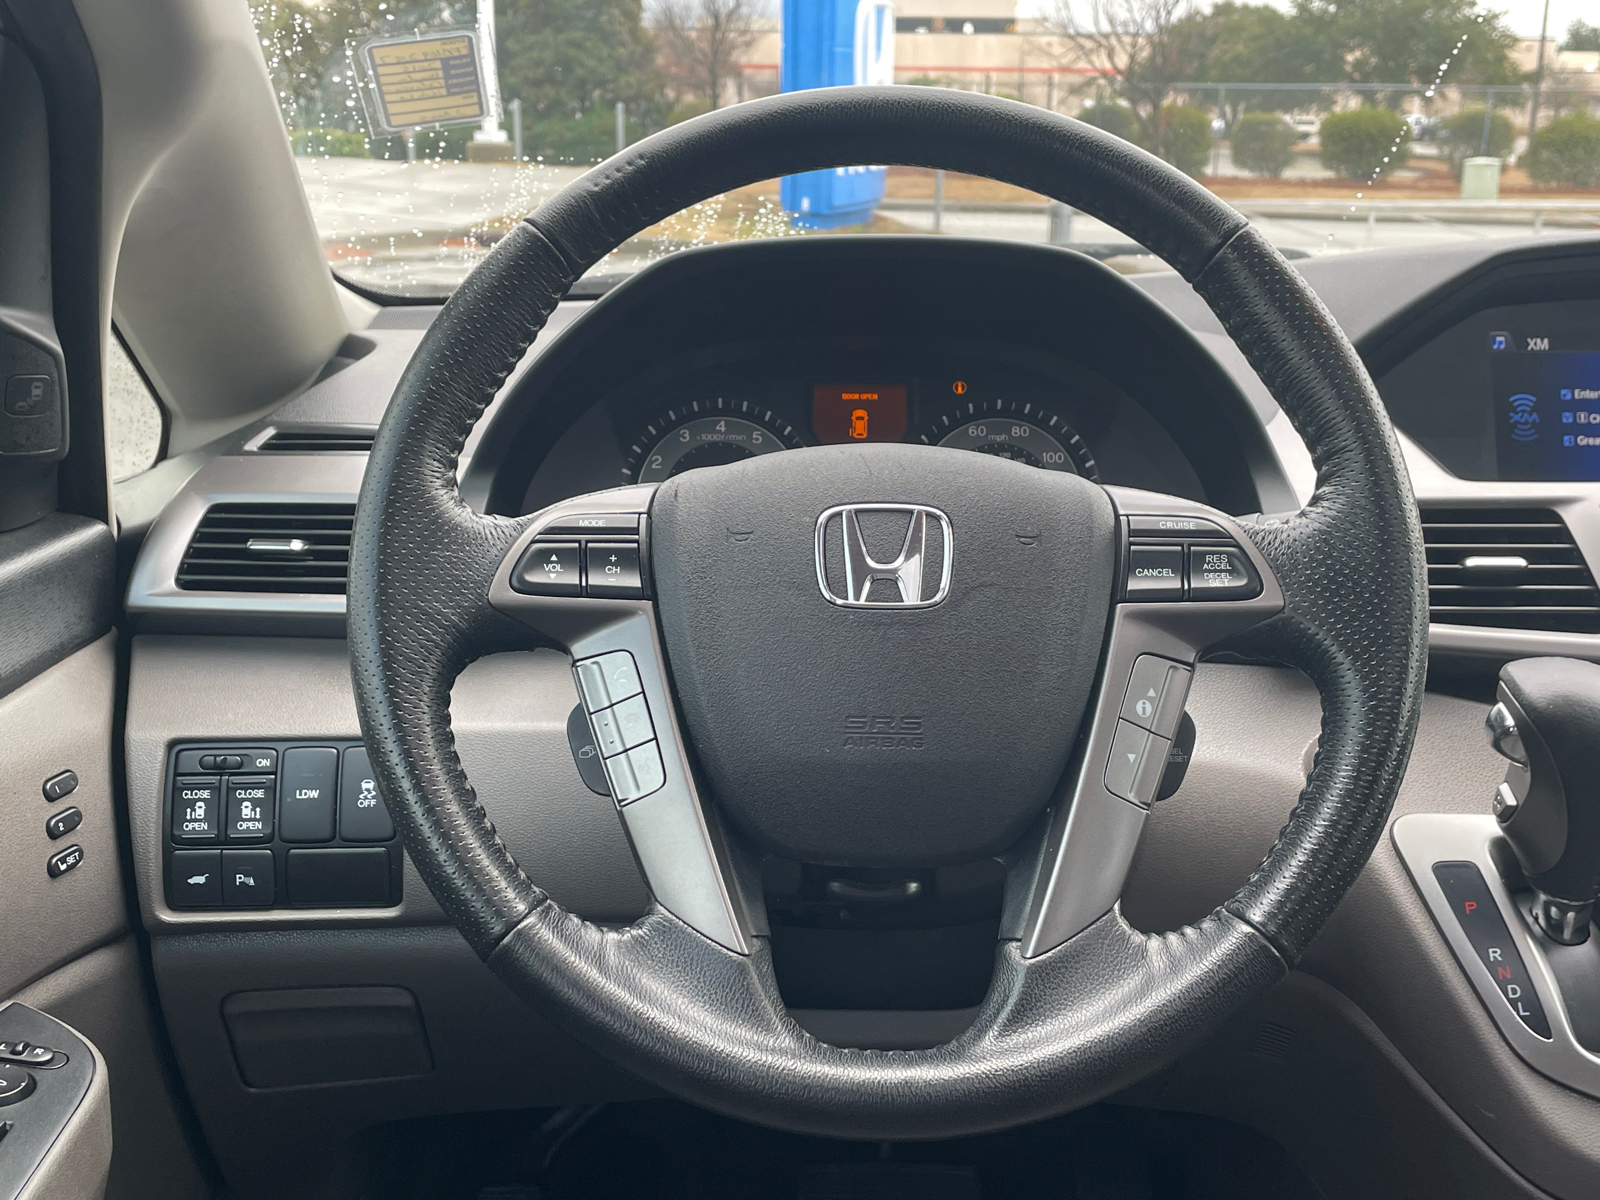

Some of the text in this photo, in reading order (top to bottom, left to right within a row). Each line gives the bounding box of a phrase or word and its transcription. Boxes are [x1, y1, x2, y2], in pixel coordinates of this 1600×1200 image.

[1527, 338, 1550, 351] XM
[716, 420, 726, 433] 4
[968, 425, 987, 437] 60
[1011, 425, 1029, 437] 80
[680, 429, 690, 442] 3
[752, 431, 762, 444] 5
[988, 433, 1008, 442] mph
[651, 455, 662, 469] 2
[1042, 451, 1065, 463] 100
[579, 519, 606, 527] MODE
[1159, 521, 1196, 530] CRUISE
[1205, 554, 1228, 563] RES
[543, 563, 564, 572] VOL
[605, 565, 620, 574] CH
[1135, 568, 1175, 577] CANCEL
[1208, 579, 1230, 587] SET
[844, 715, 923, 733] SRS
[256, 758, 270, 767] ON
[182, 790, 211, 799] CLOSE
[236, 789, 265, 798] CLOSE
[296, 789, 319, 799] LDW
[357, 799, 377, 808] OFF
[58, 822, 65, 831] 2
[183, 821, 208, 831] OPEN
[237, 821, 262, 830] OPEN
[66, 851, 80, 865] SET
[1464, 901, 1477, 914] P
[1488, 948, 1502, 962] R
[1498, 966, 1511, 980] N
[1507, 984, 1521, 999] D
[1518, 1002, 1530, 1016] L
